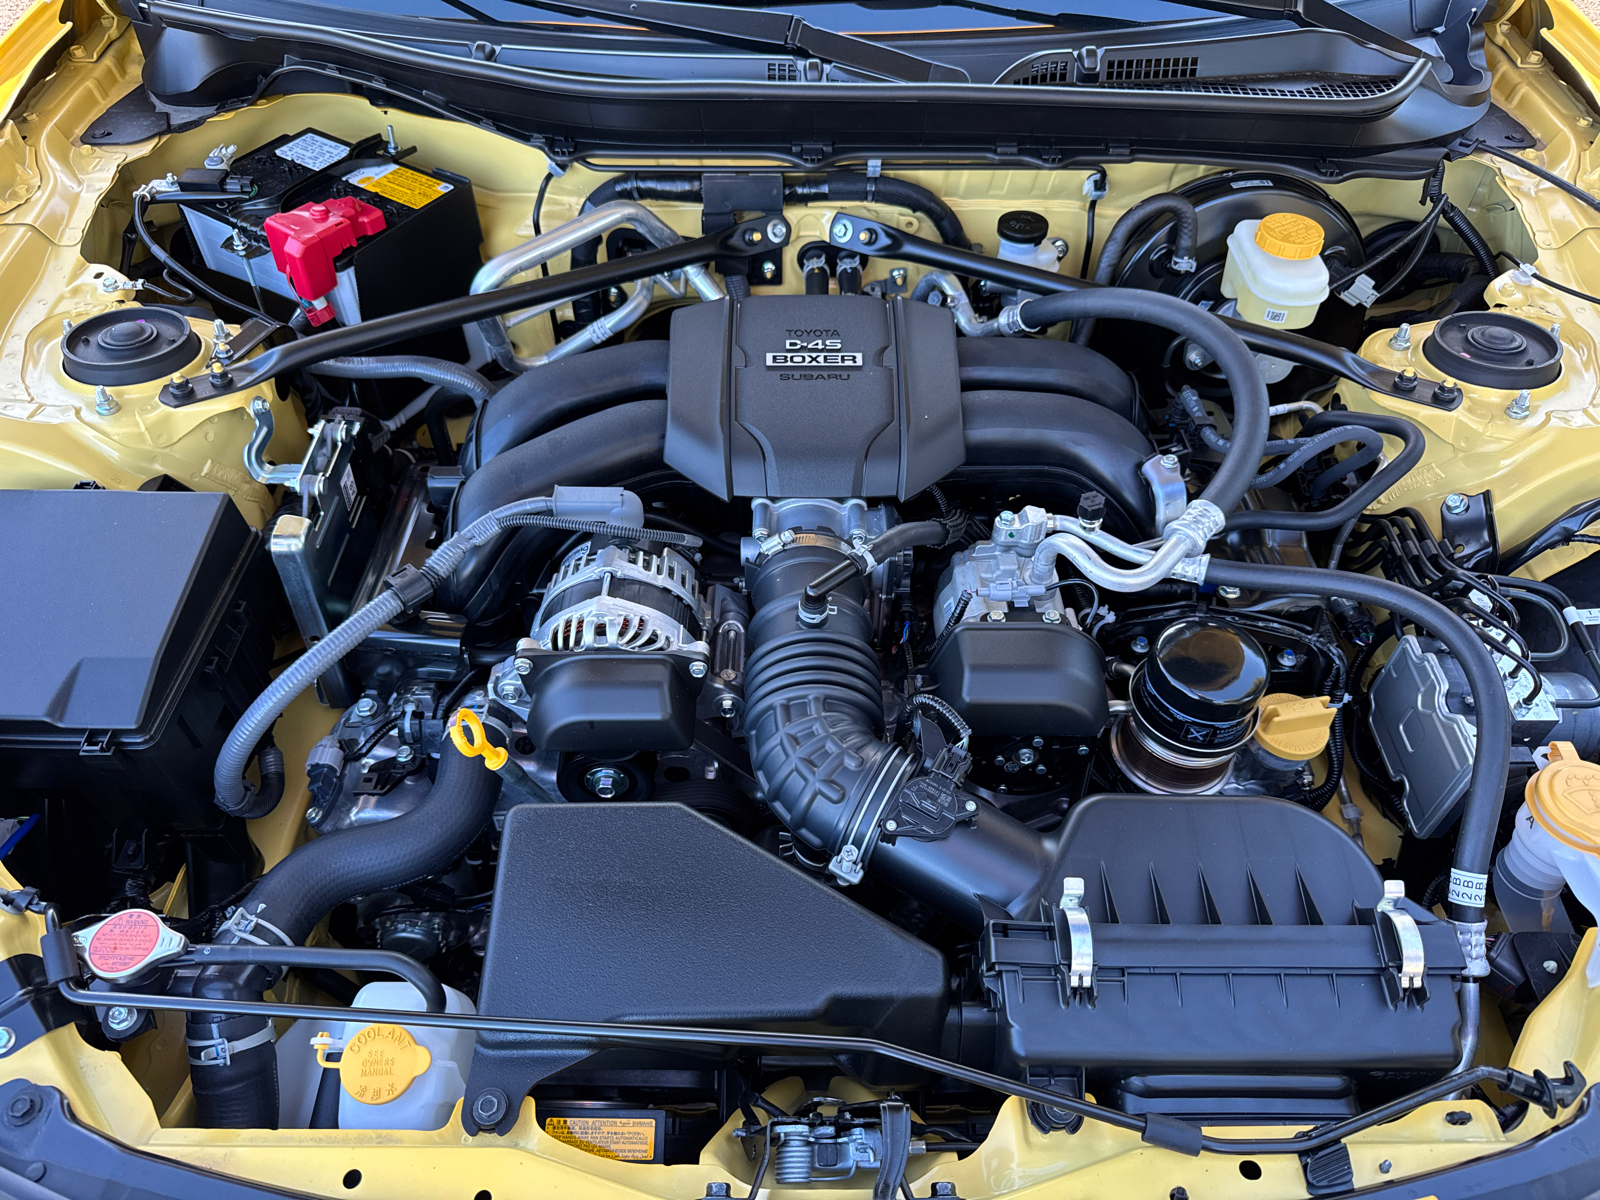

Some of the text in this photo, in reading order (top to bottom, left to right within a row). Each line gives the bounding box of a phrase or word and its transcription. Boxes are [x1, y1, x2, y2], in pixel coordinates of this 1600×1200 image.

[786, 329, 840, 337] TOYOTA
[785, 339, 842, 350] D-4S
[772, 355, 857, 364] BOXER
[349, 1027, 412, 1054] COOLANT
[368, 1048, 385, 1057] SEE
[360, 1067, 394, 1077] MANUAL
